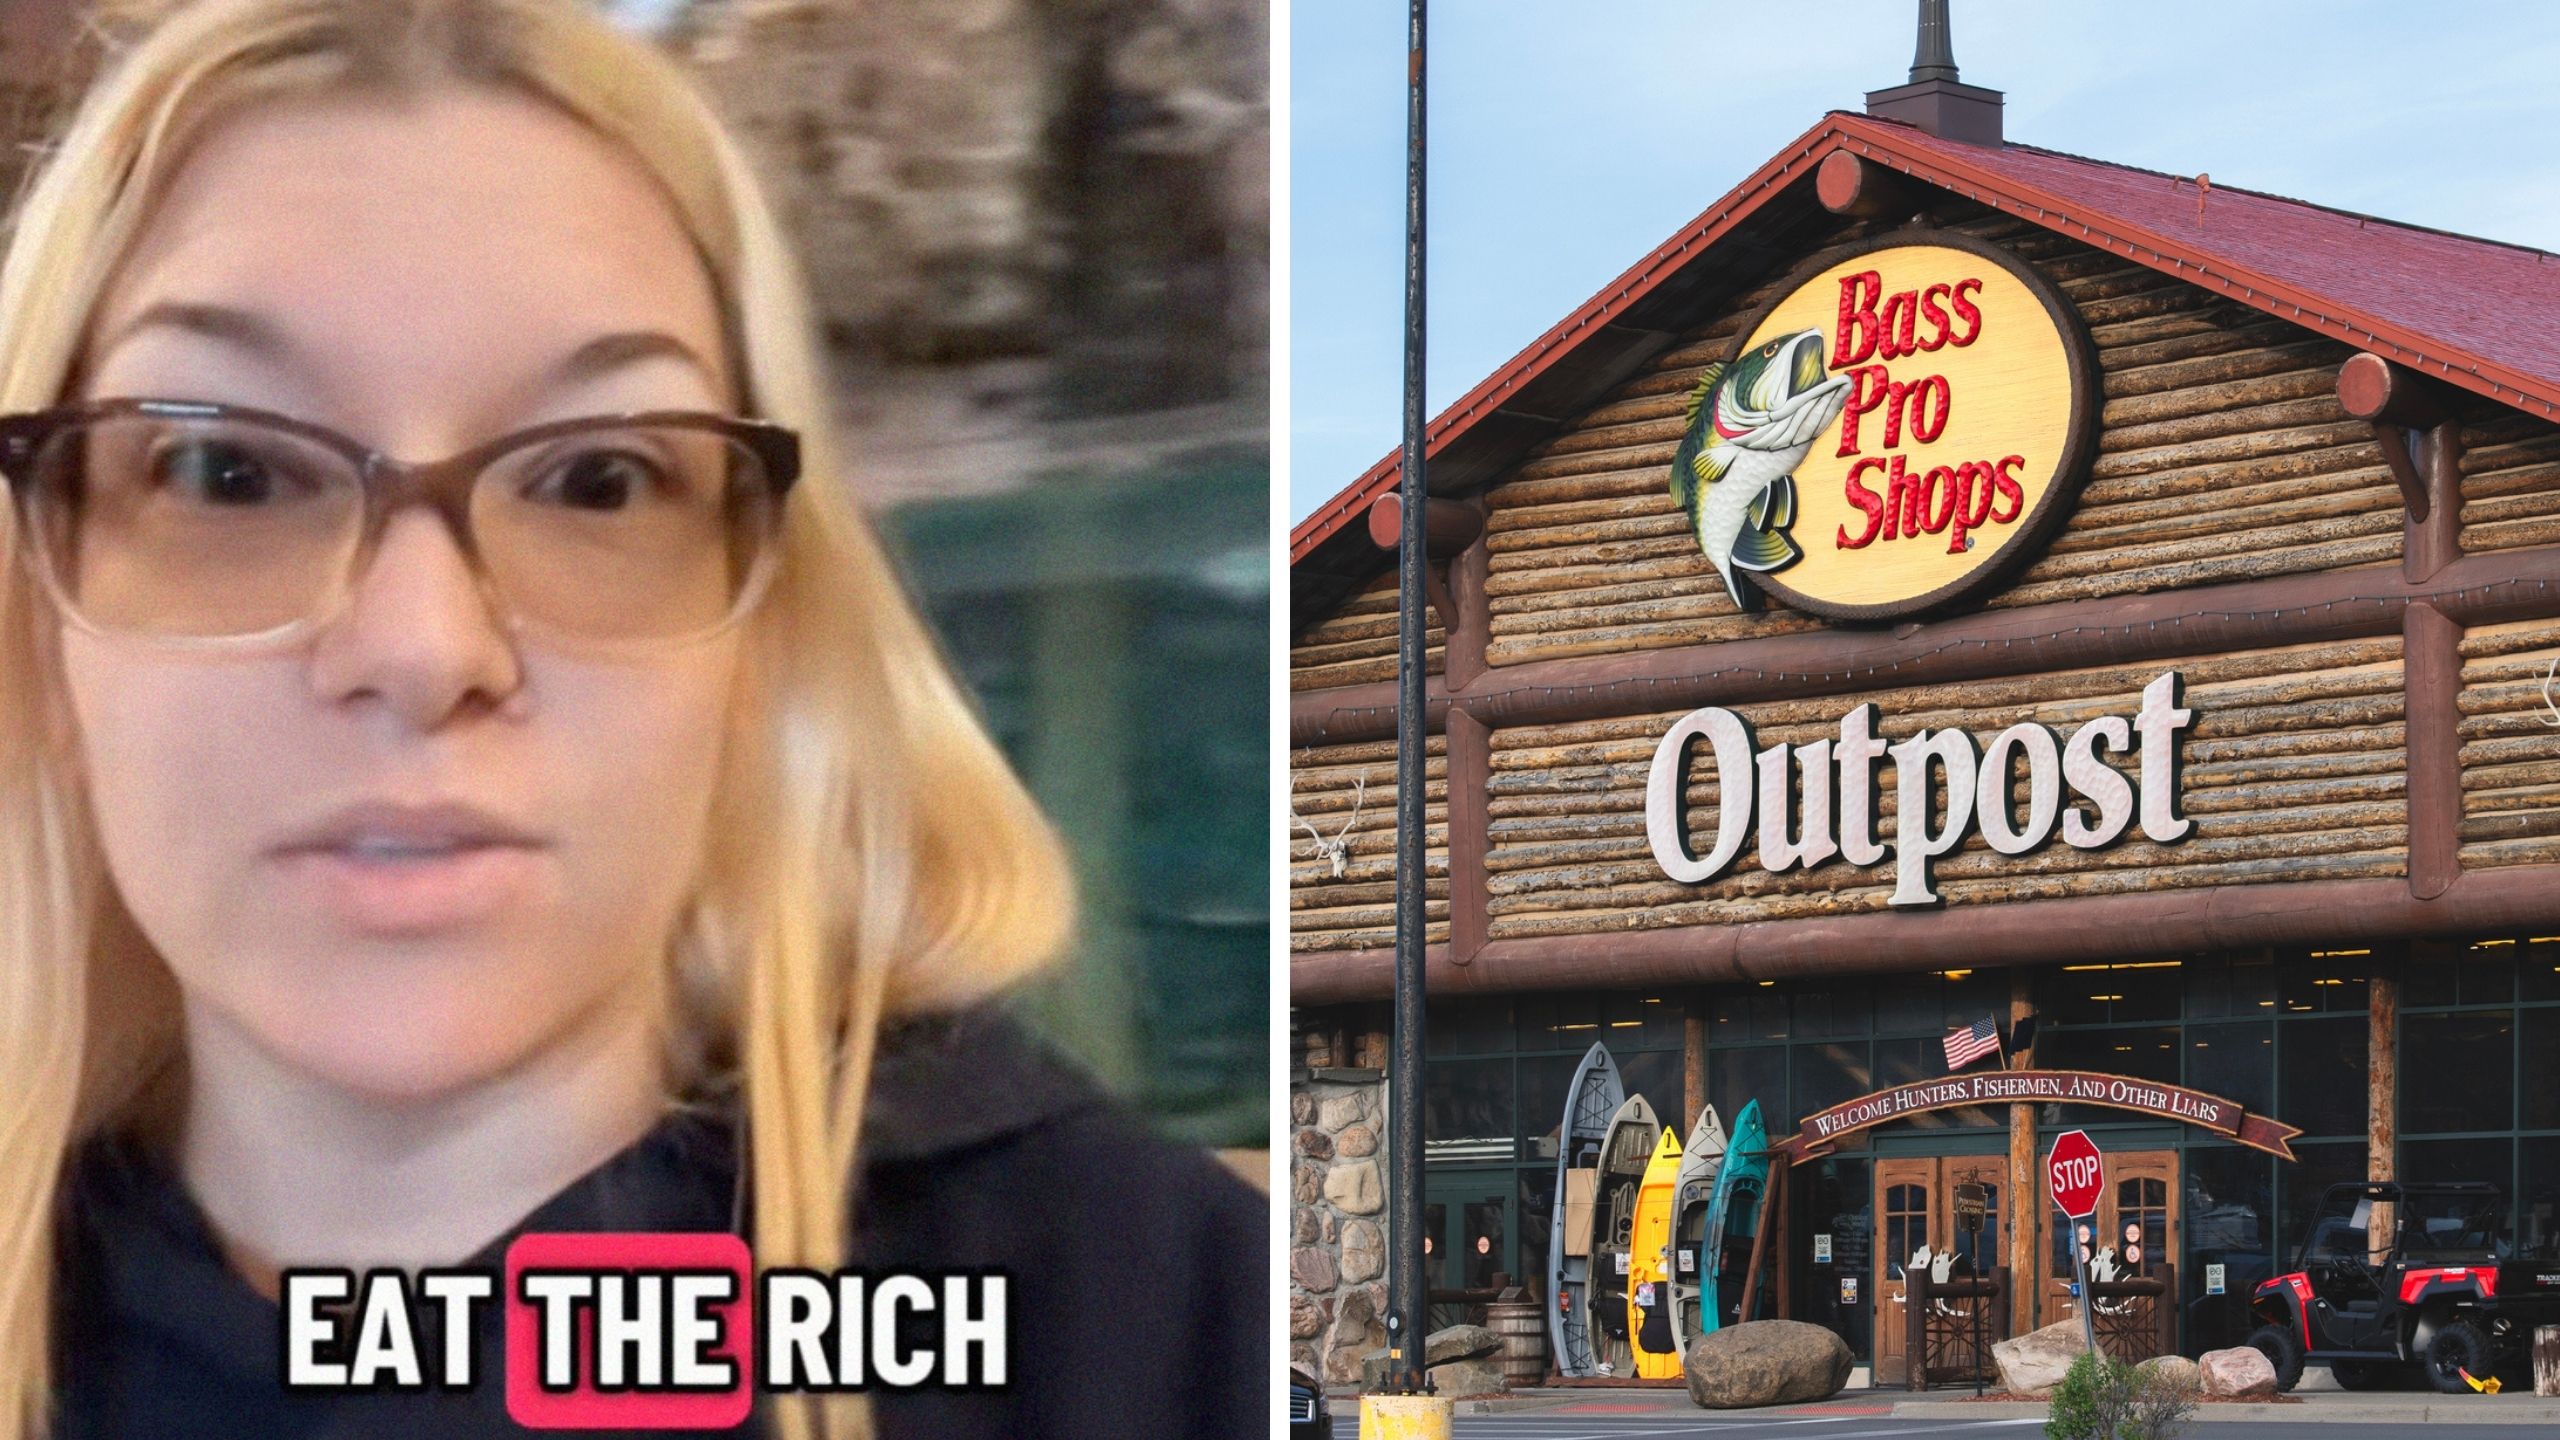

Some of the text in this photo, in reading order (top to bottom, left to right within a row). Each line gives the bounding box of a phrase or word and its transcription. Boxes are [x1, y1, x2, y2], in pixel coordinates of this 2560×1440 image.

[1829, 270, 1983, 370] Bass
[1836, 363, 1951, 458] Pro
[1836, 454, 2026, 554] Shops
[1645, 671, 2192, 905] Outpost
[1815, 1076, 2219, 1137] WELCOME HUNTERS, FISHERMEN, AND OTHER LIARS
[2052, 1155, 2098, 1193] STOP
